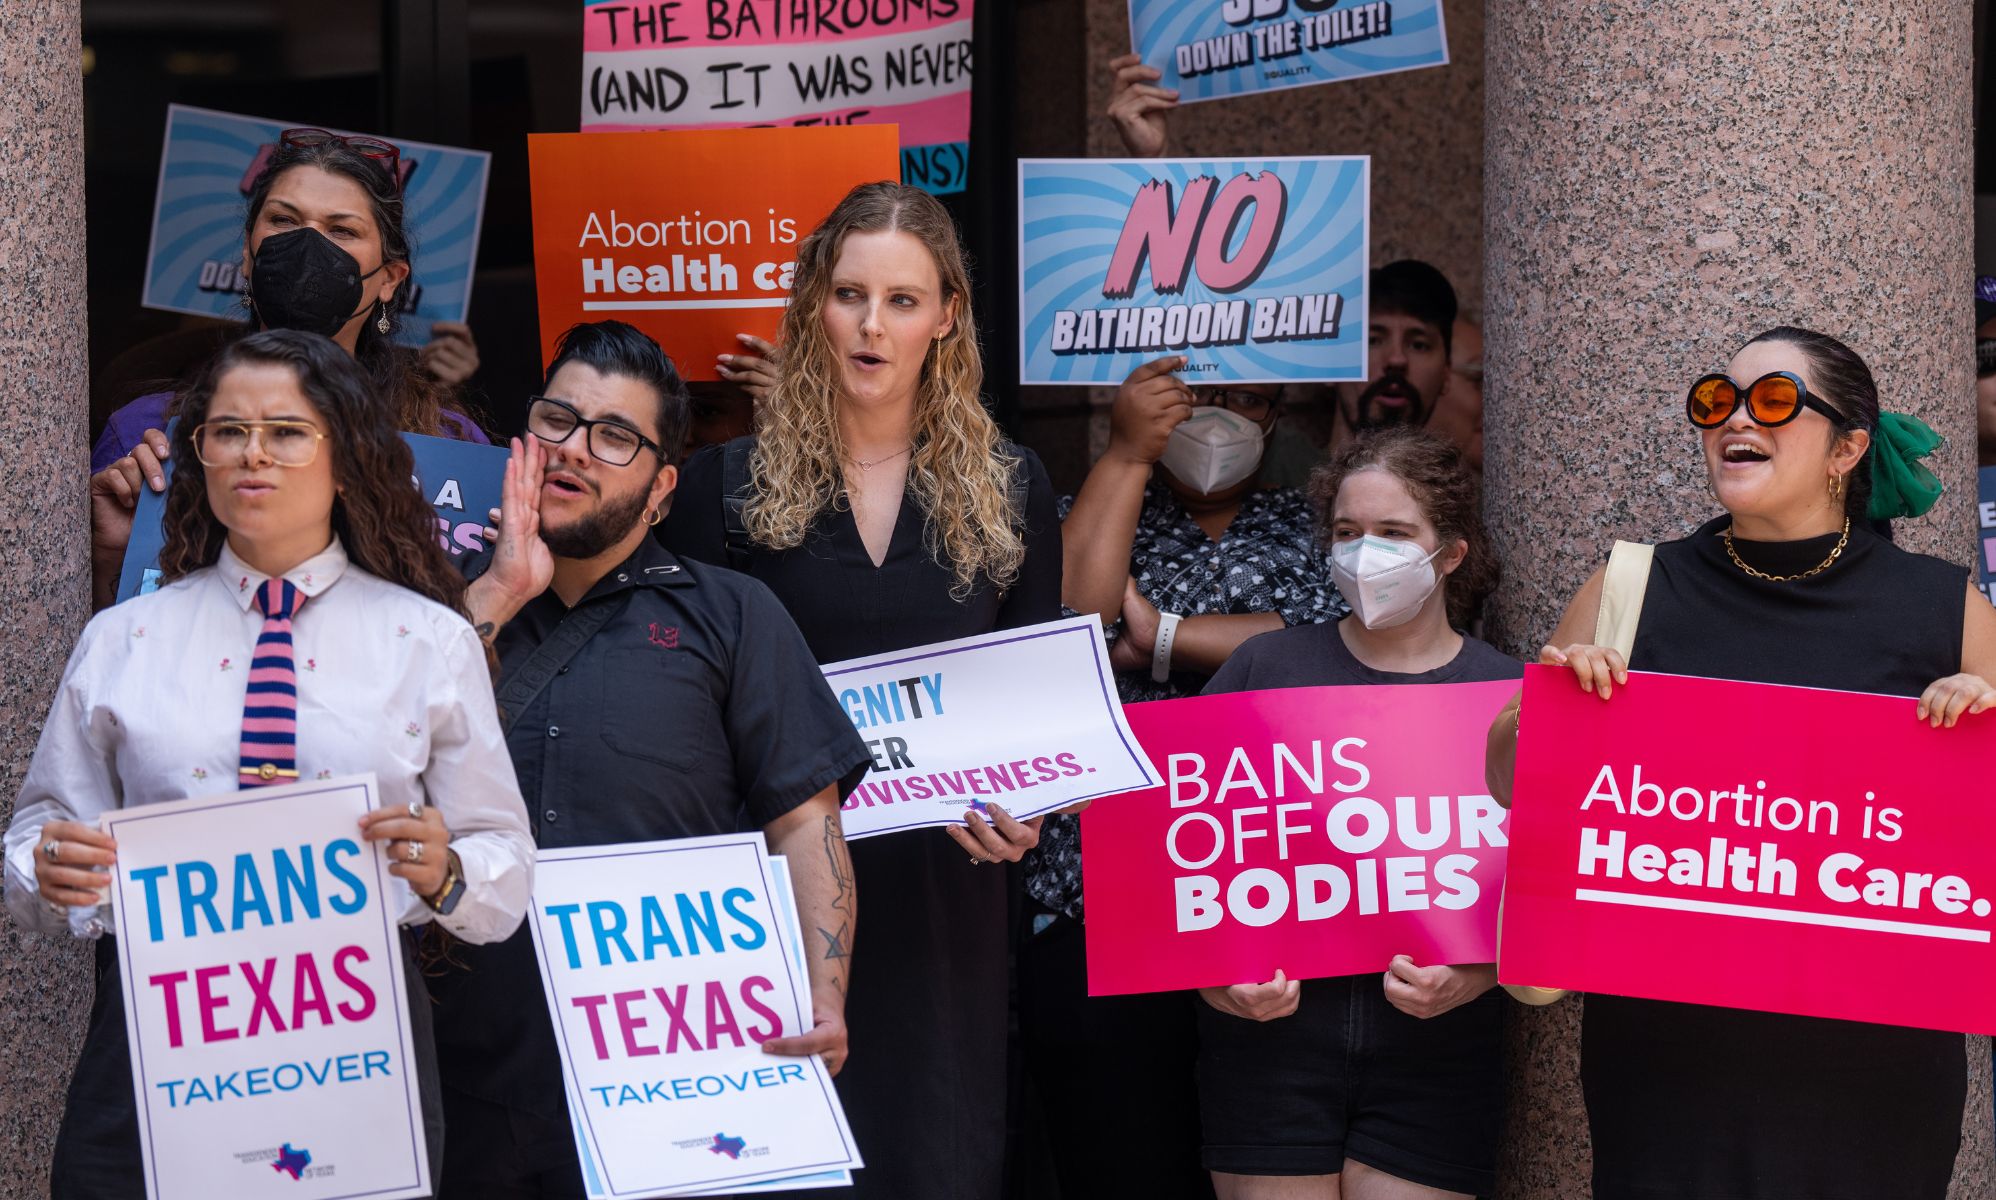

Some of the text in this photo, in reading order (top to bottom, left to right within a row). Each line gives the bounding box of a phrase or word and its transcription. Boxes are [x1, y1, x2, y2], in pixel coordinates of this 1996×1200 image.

[593, 2, 690, 47] THE
[1175, 31, 1251, 77] DOWN
[1254, 21, 1300, 60] THE
[1302, 1, 1390, 51] TOILET!
[590, 40, 972, 116] (AND IT WAS NEVER
[578, 208, 797, 247] Abortion is
[1103, 169, 1287, 300] NO
[582, 253, 796, 293] Health ca
[1050, 293, 1344, 356] BATHROOM BAN!
[840, 672, 945, 730] GNITY
[863, 736, 916, 773] ER
[1167, 737, 1371, 808] BANS
[1166, 795, 1509, 869] OFF OUR
[1580, 764, 1904, 842] Abortion is
[129, 838, 368, 943] TRANS
[1174, 853, 1480, 933] BODIES
[1577, 827, 1992, 917] Health Care.
[544, 887, 767, 970] TRANS
[148, 944, 377, 1049] TEXAS
[571, 976, 784, 1060] TEXAS
[156, 1050, 392, 1108] TAKEOVER
[589, 1063, 807, 1109] TAKEOVER
